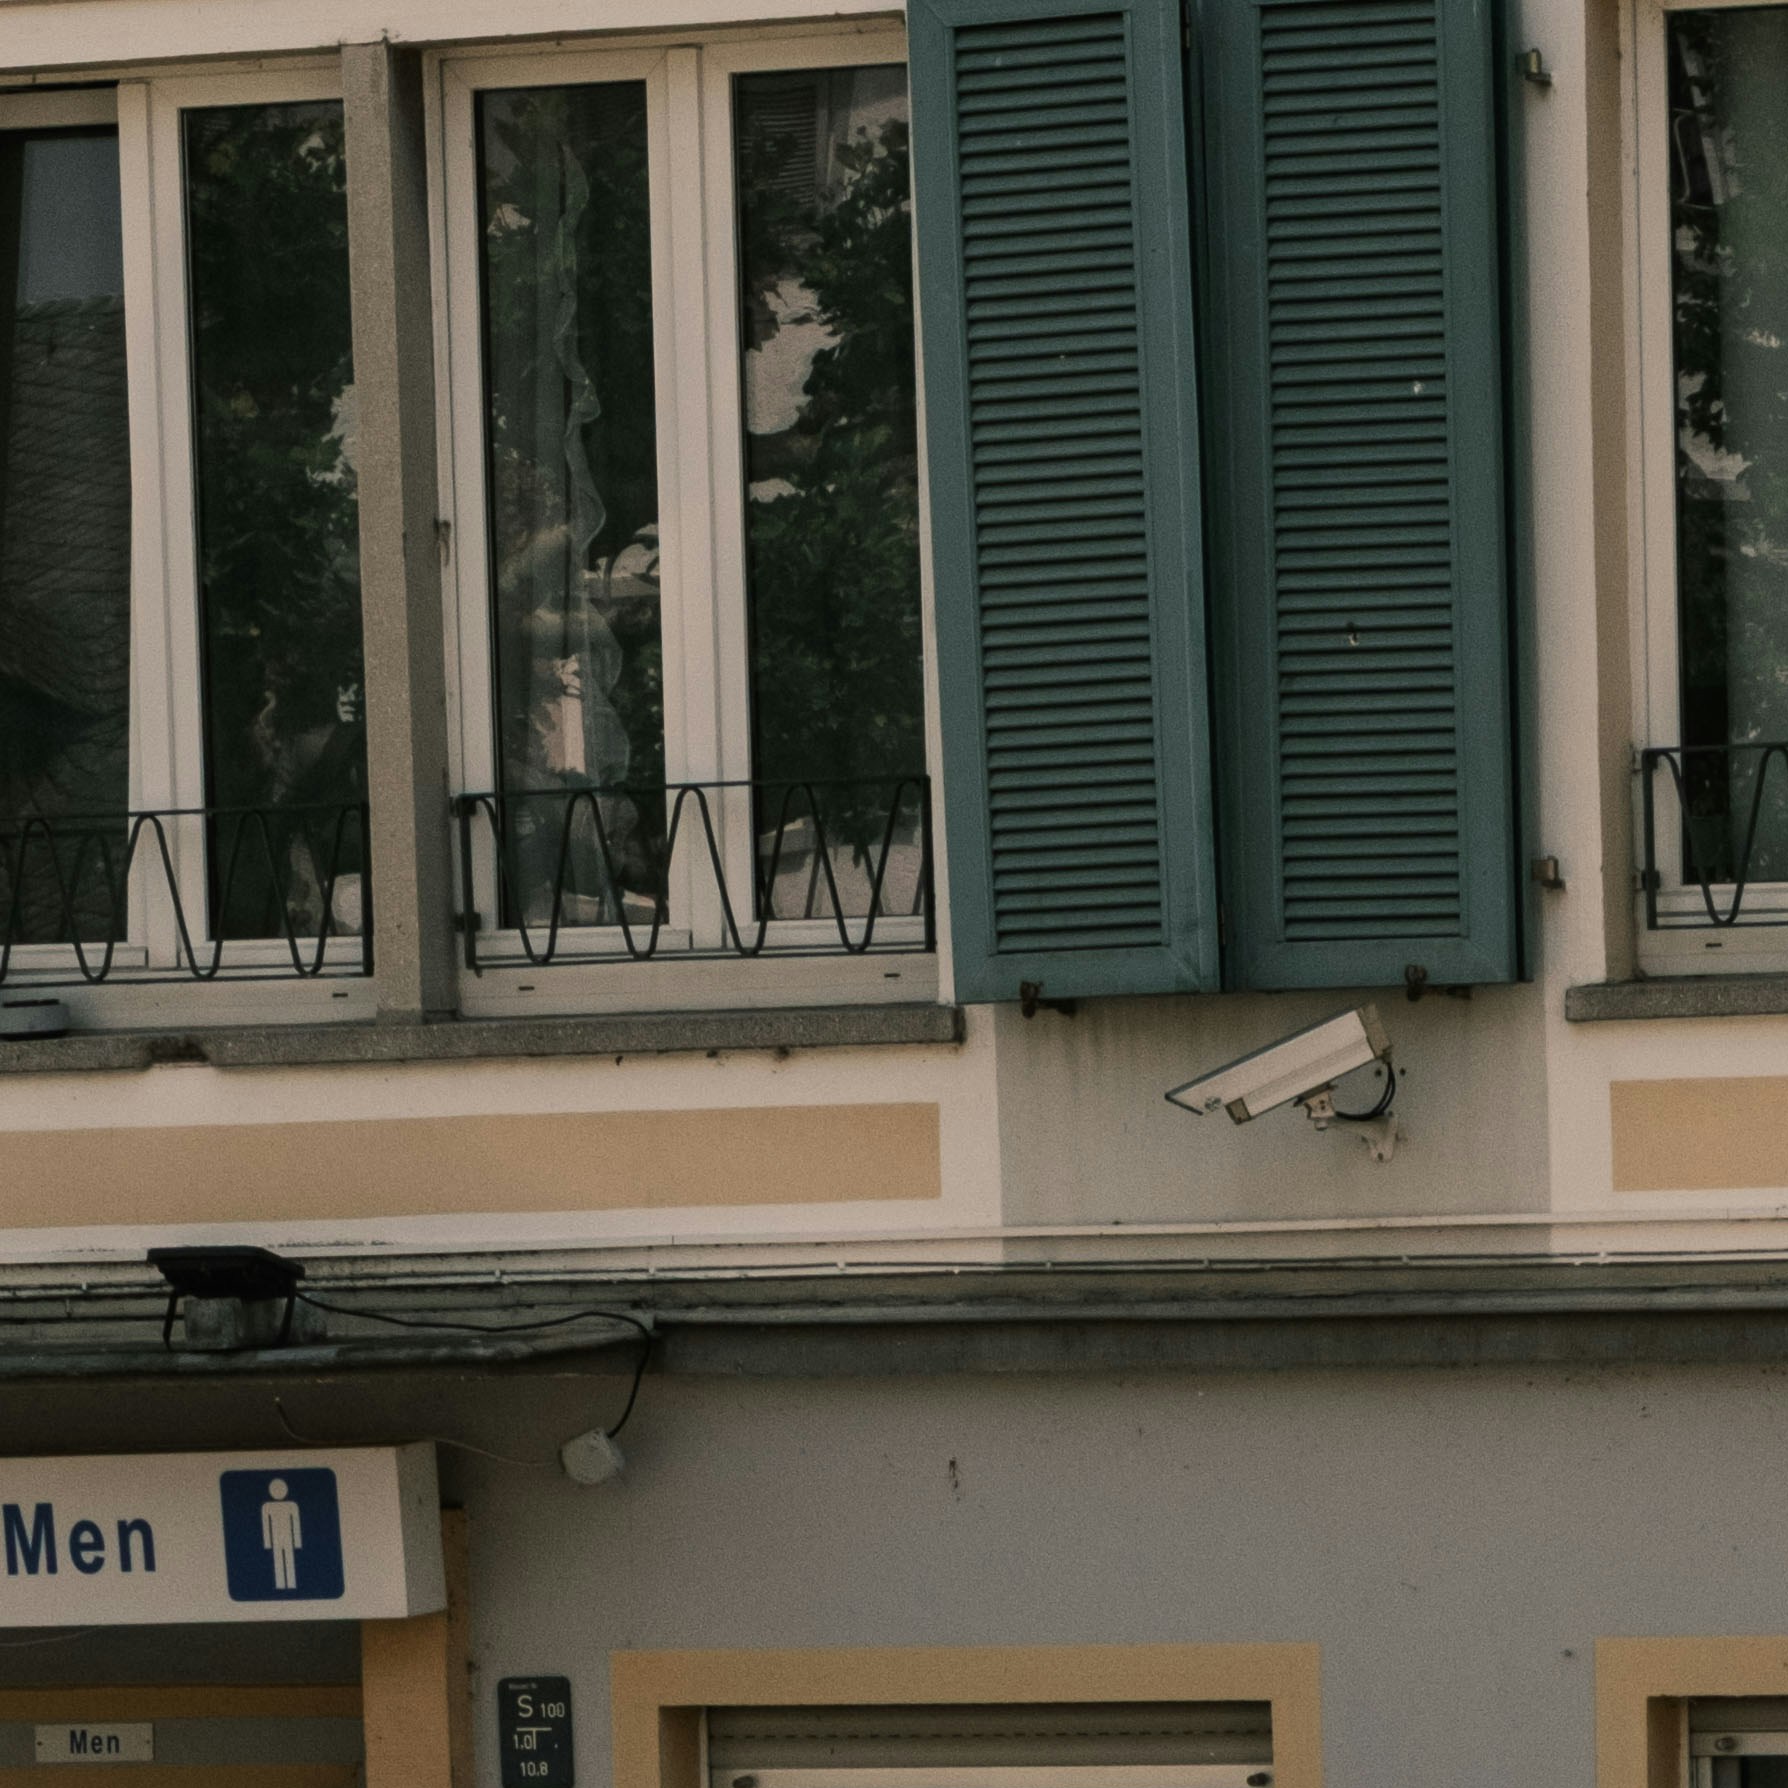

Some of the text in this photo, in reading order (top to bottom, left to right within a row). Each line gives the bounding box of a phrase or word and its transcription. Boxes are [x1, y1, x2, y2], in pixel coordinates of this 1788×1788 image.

[2, 1502, 156, 1577] Men
[517, 1694, 565, 1718] S 100
[69, 1729, 120, 1755] Men
